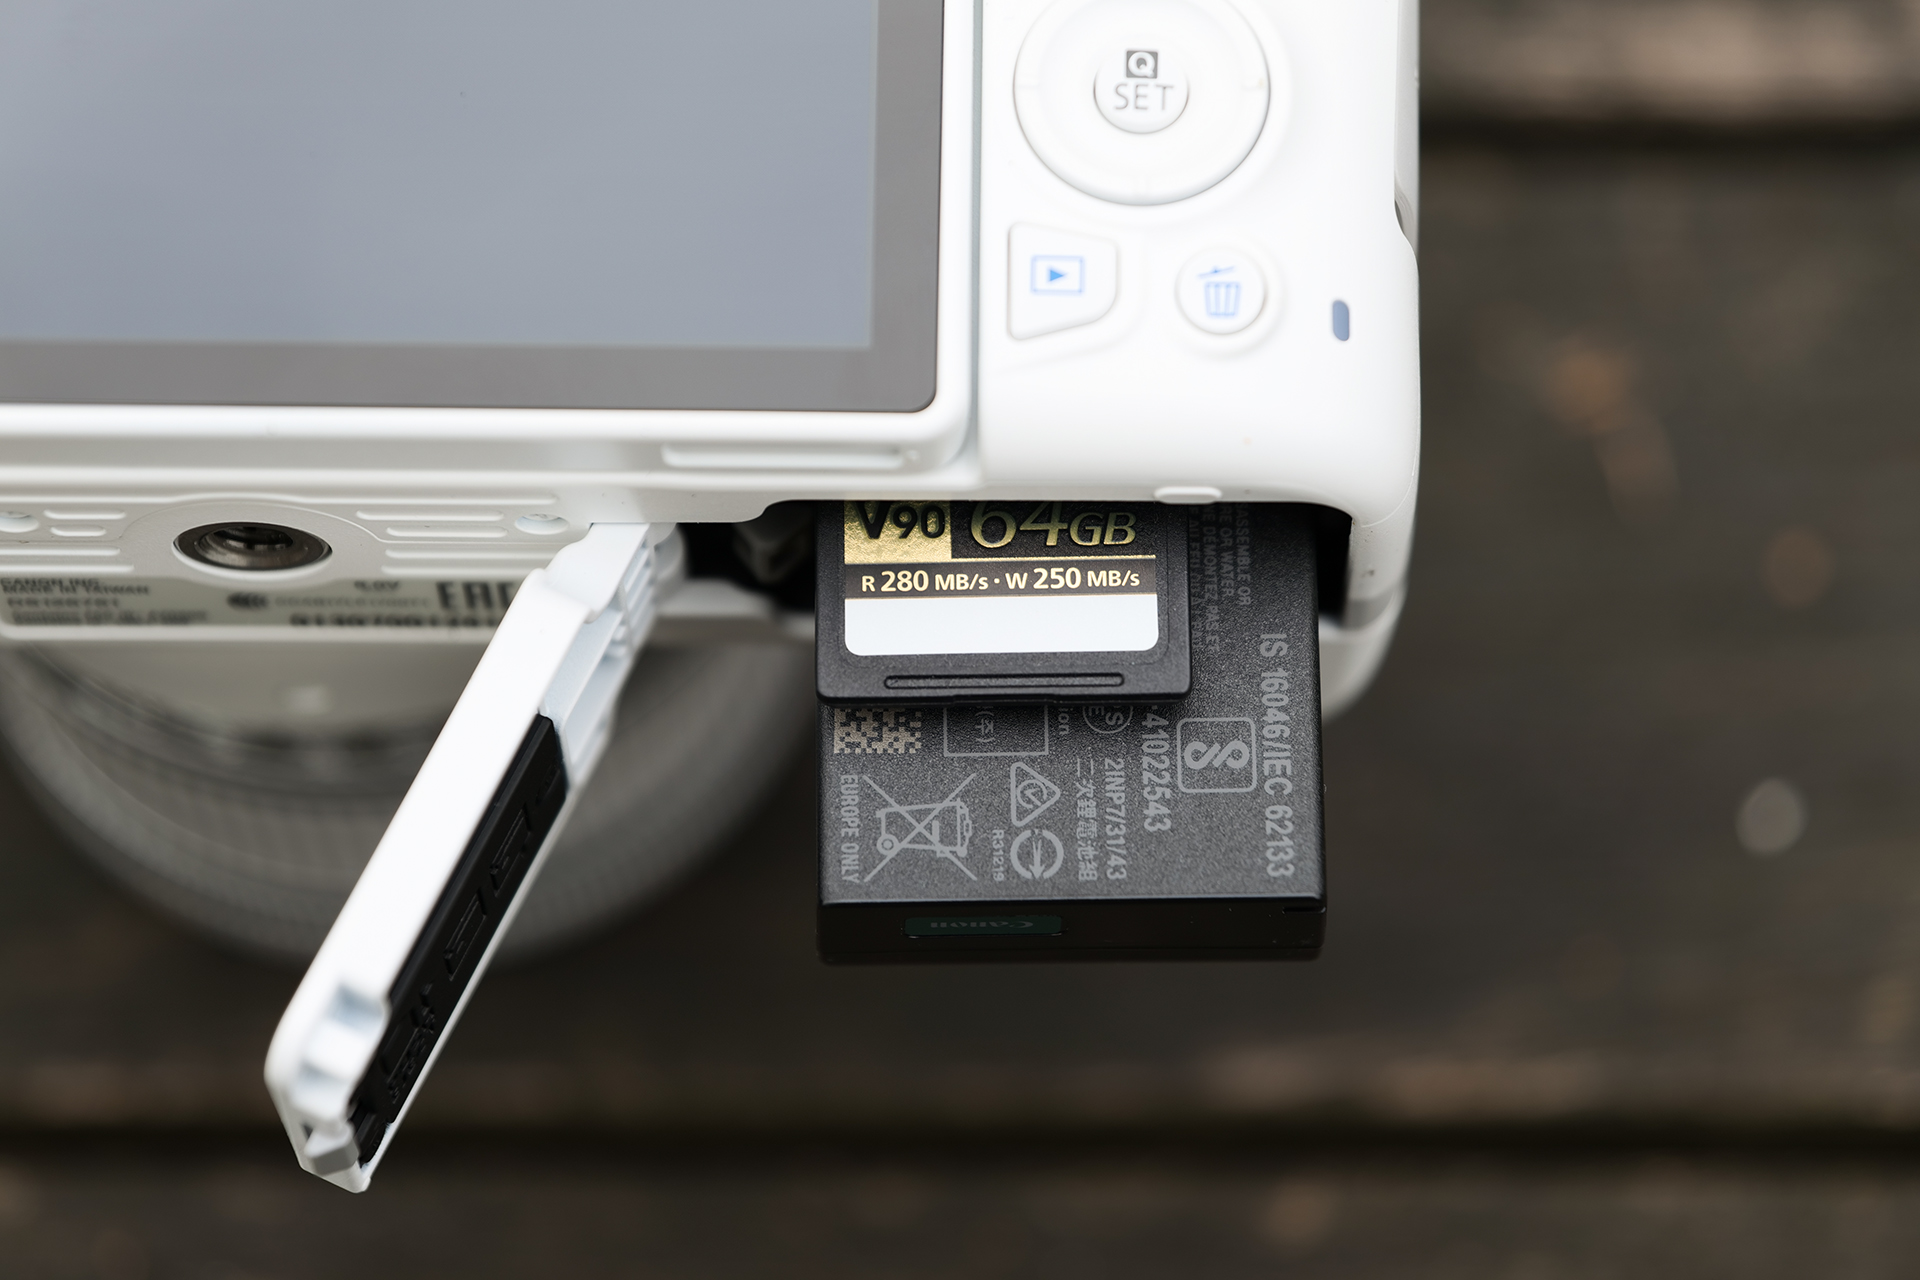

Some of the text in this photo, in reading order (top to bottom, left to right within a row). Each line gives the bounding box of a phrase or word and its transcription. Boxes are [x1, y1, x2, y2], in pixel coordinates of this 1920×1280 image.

[1113, 82, 1174, 111] SET
[855, 501, 946, 540] V90
[969, 501, 1138, 549] 64GB
[1220, 527, 1233, 547] OR
[861, 575, 876, 593] R
[881, 569, 929, 593] 280
[934, 572, 989, 592] MB/s
[1004, 572, 1028, 591] W
[1032, 567, 1082, 590] 250
[1086, 569, 1141, 588] MB/s
[1220, 550, 1235, 598] WATER
[1206, 604, 1219, 632] PAS
[1206, 635, 1219, 652] ET
[1259, 633, 1296, 879] IS 16046/IEC 62133
[840, 774, 860, 884] EUROPE ONLY
[991, 829, 1005, 882] R31219
[930, 920, 1034, 929] Canon
